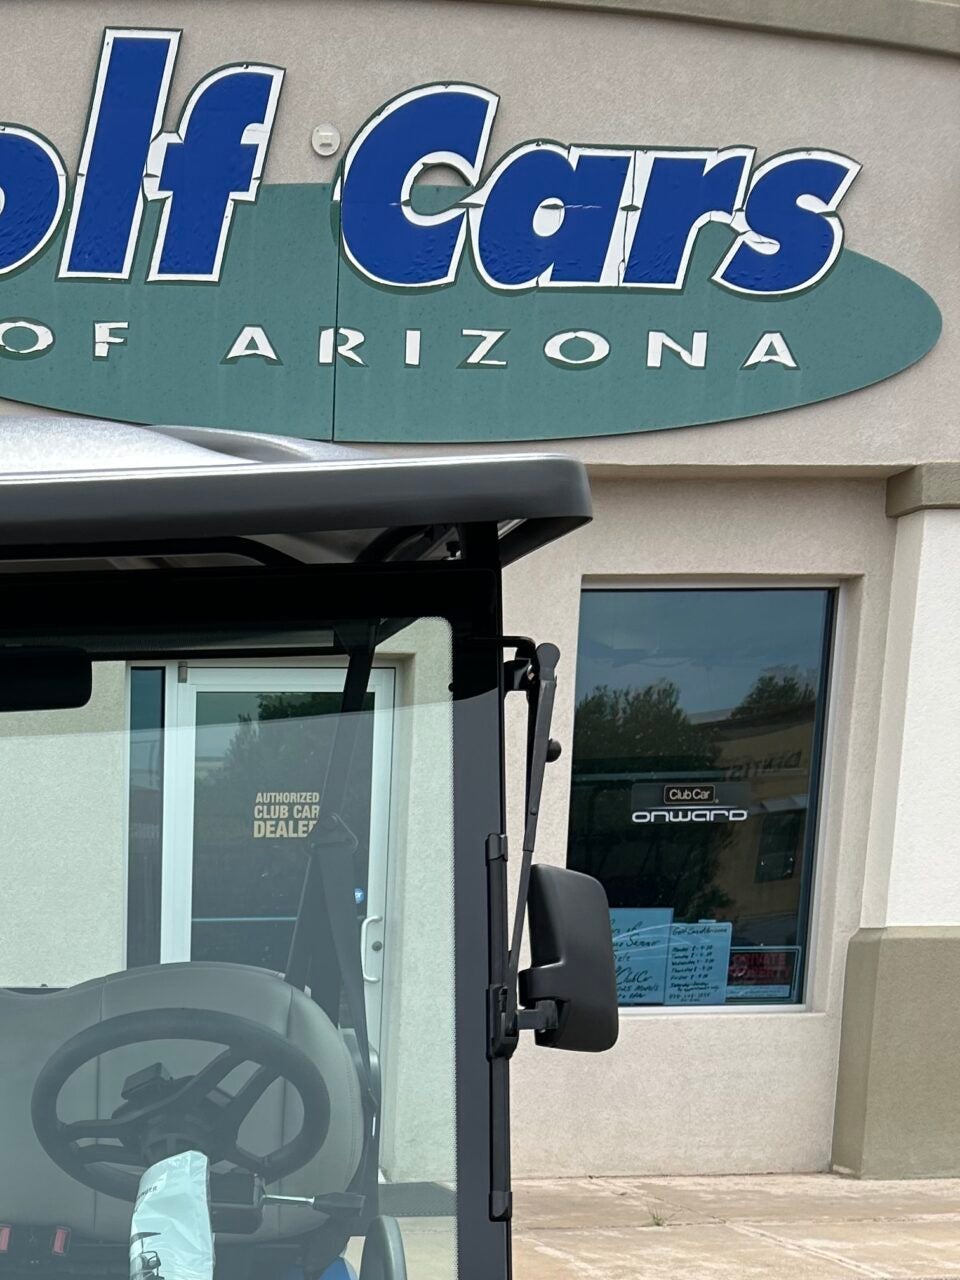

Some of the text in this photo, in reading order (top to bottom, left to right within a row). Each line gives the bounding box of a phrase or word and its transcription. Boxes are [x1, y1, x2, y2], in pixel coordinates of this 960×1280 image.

[334, 81, 864, 294] Cars
[222, 328, 800, 371] ARIZONA
[255, 792, 320, 804] AUTHORIZED
[668, 788, 711, 800] Club Car
[253, 805, 321, 819] CLUB CAR
